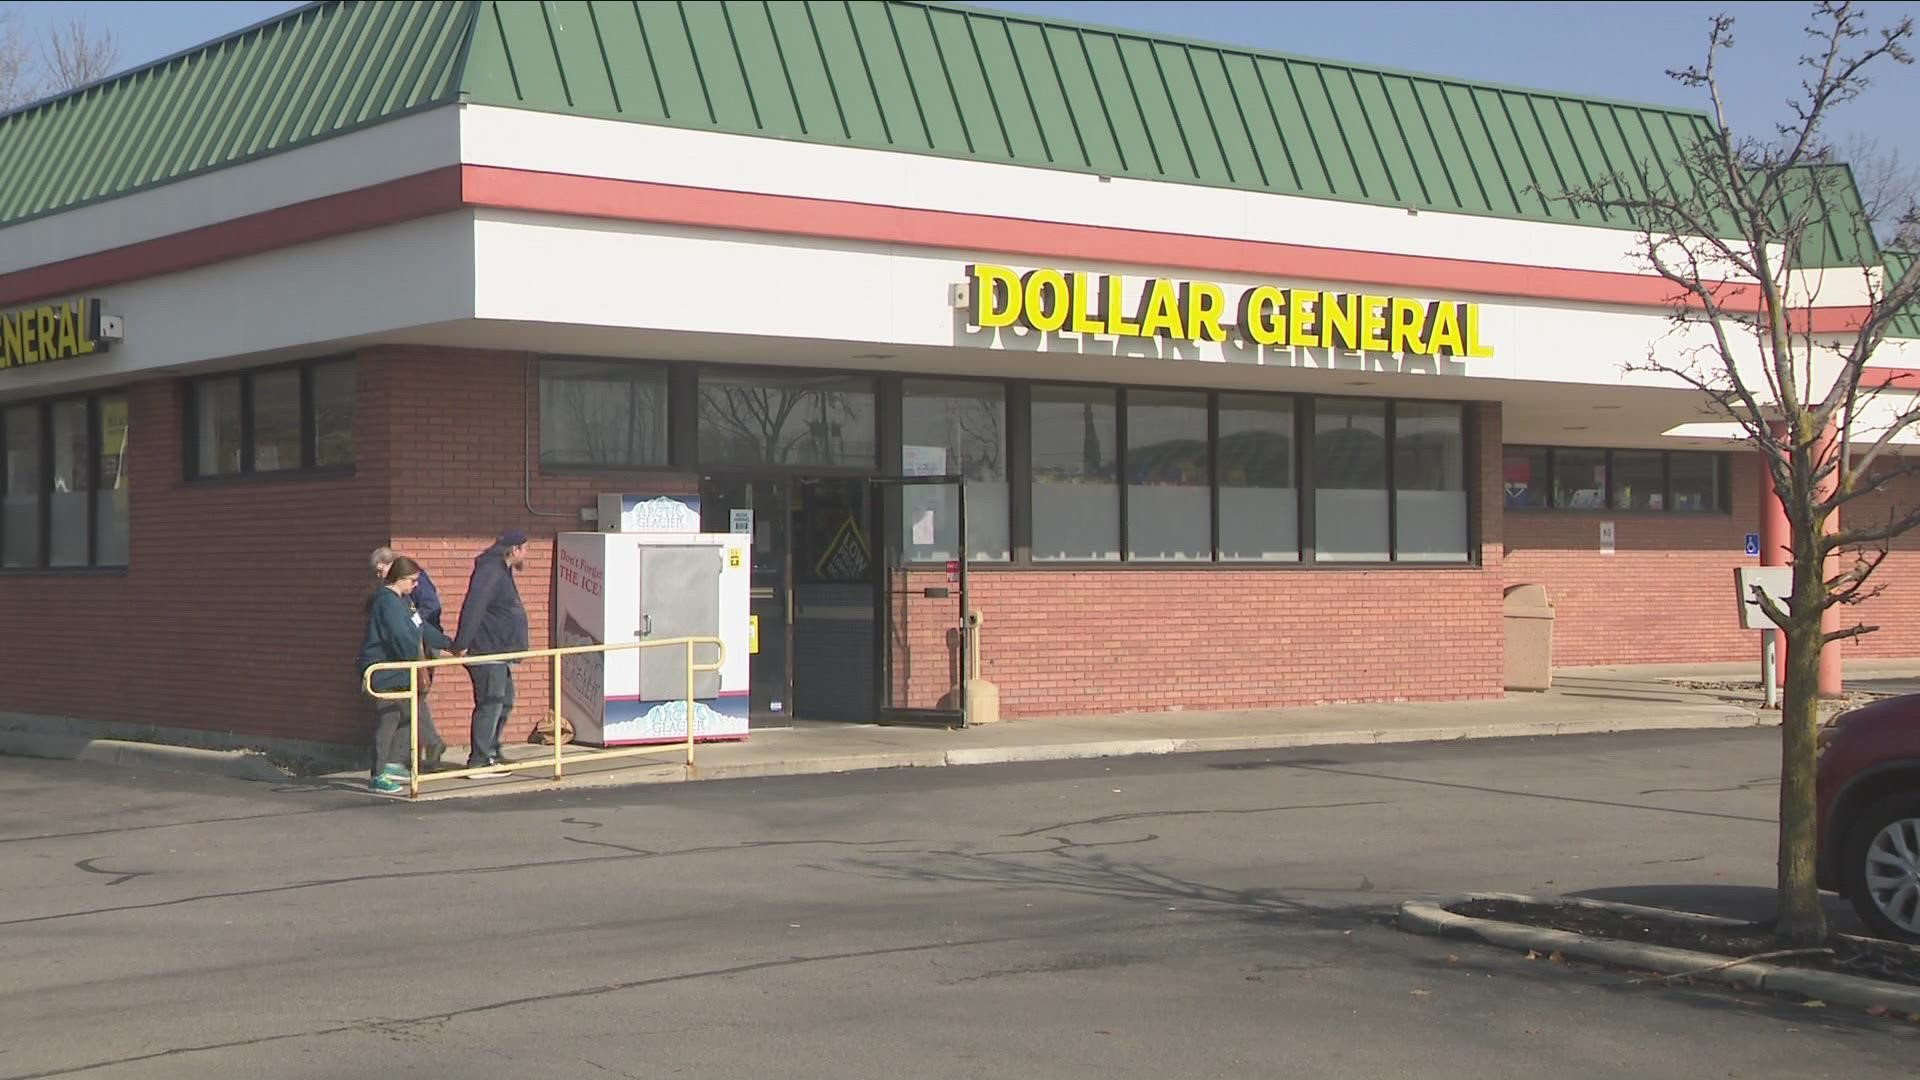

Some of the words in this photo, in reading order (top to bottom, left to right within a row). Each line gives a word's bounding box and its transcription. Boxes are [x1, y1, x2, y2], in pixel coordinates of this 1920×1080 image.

[972, 263, 1227, 343] DOLLAR
[1246, 285, 1495, 358] GENERAL
[560, 565, 578, 586] THE
[652, 702, 707, 721] ARCC
[652, 720, 705, 733] GLACER
